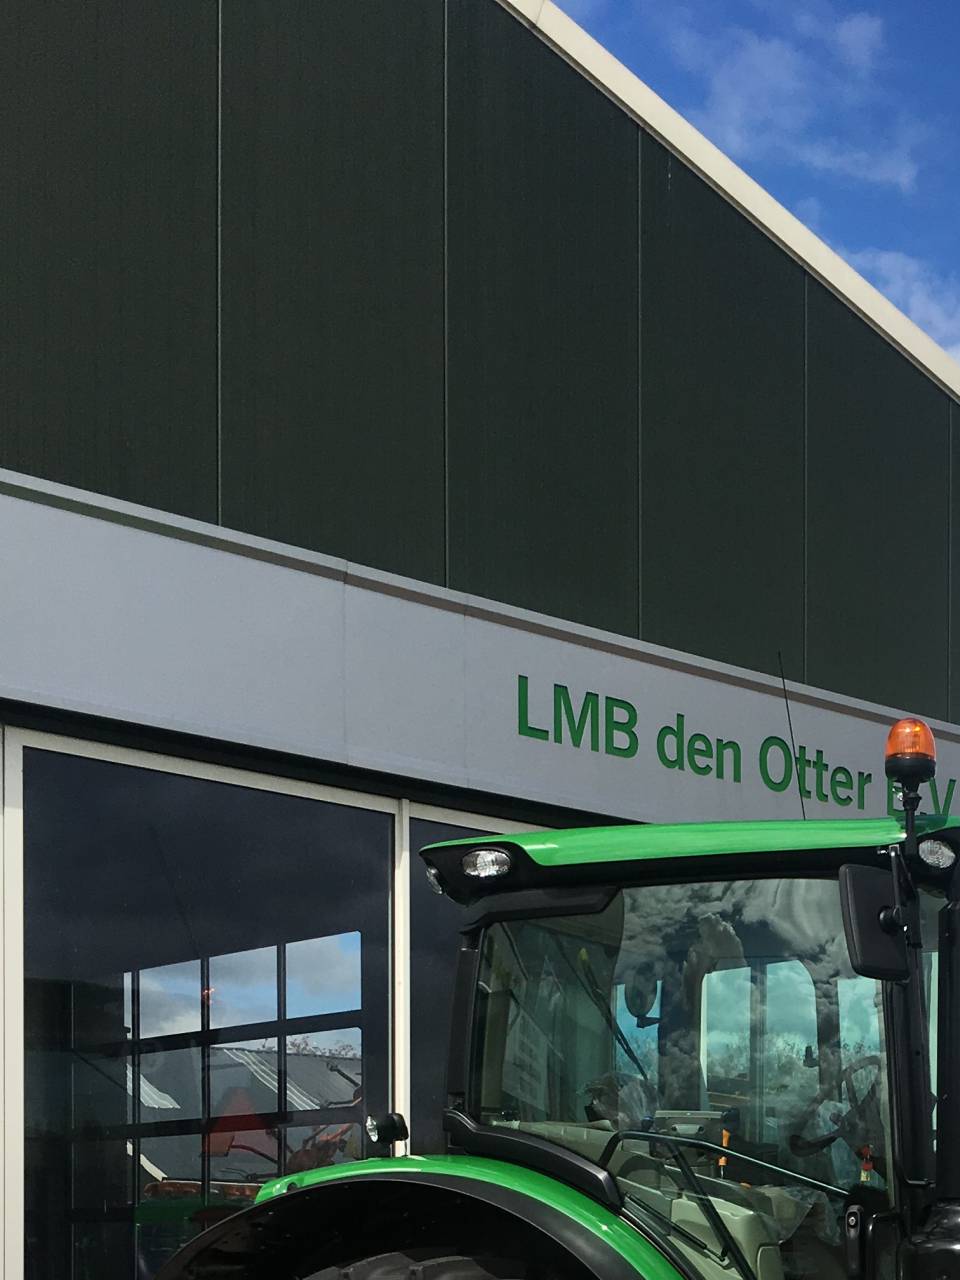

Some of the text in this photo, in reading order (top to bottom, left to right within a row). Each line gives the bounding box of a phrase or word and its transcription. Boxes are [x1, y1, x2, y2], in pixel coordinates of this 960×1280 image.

[518, 674, 639, 759] LMB
[656, 713, 742, 784] den
[759, 736, 872, 810] Otter
